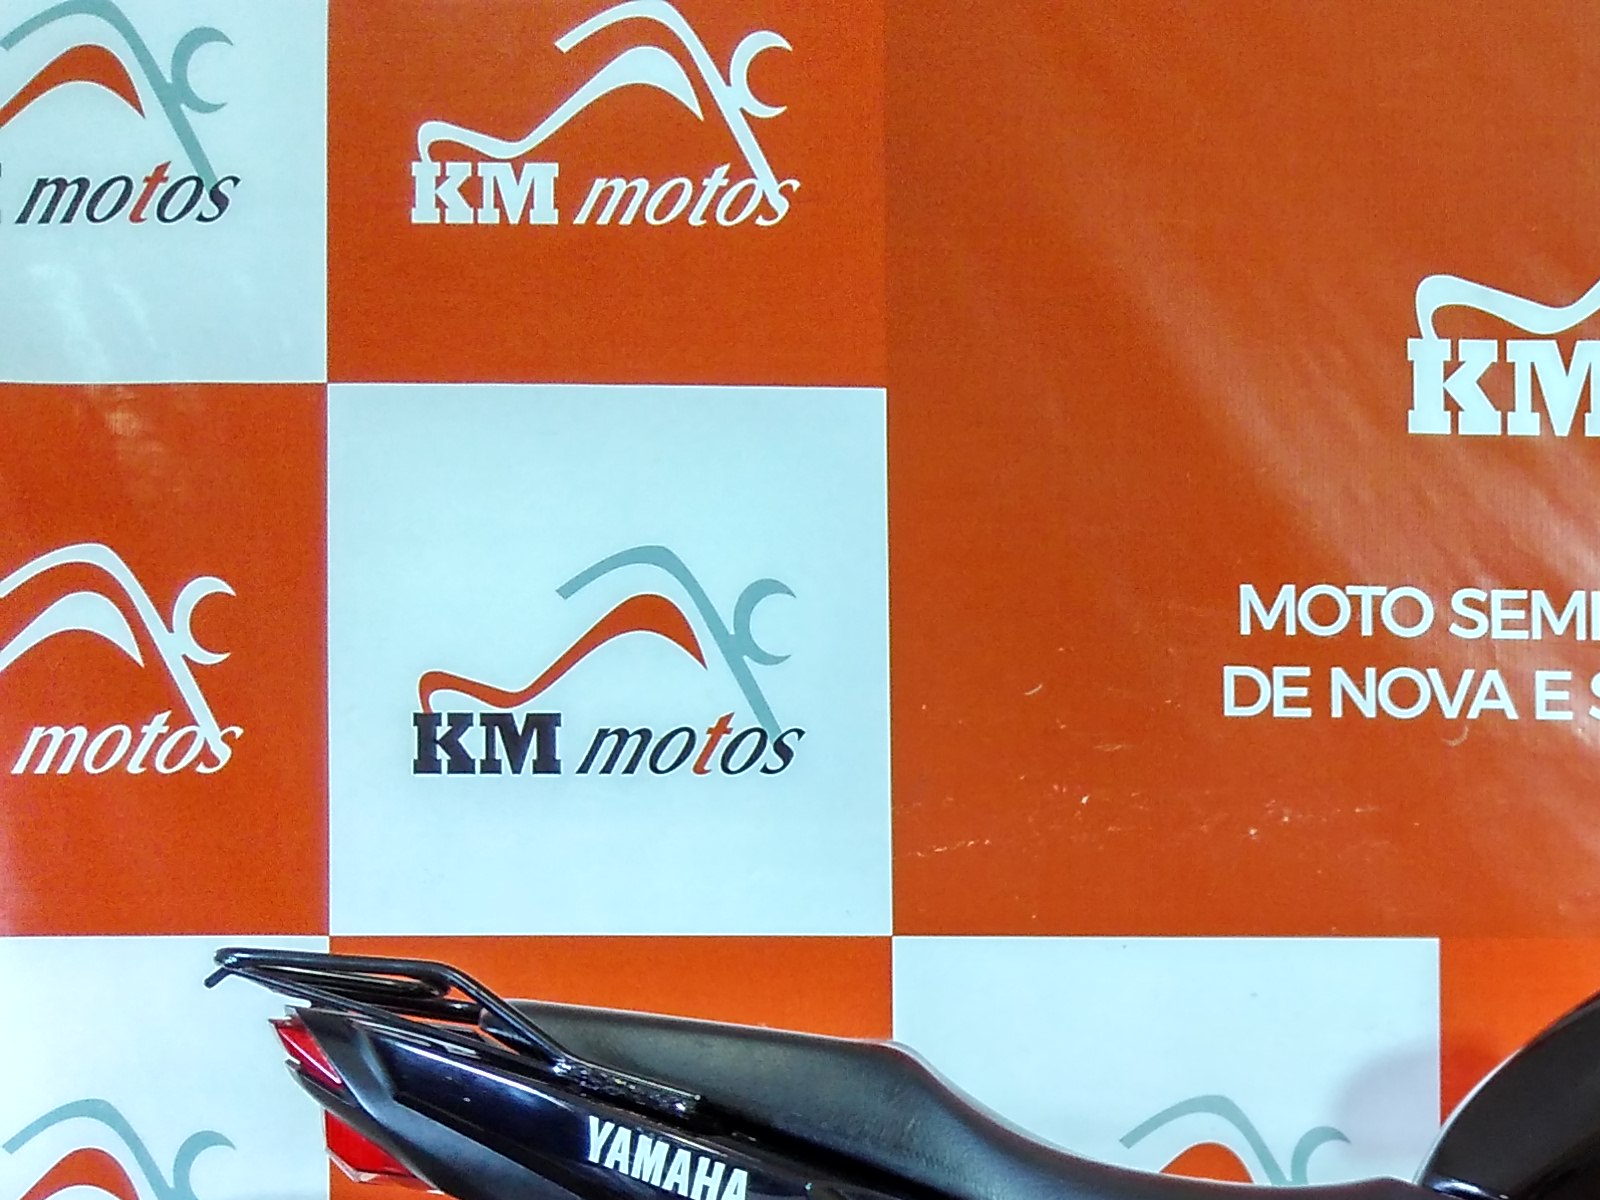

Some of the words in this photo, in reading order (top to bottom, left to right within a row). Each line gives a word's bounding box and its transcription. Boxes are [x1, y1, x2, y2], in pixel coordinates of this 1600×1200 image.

[15, 160, 241, 226] motos
[411, 162, 559, 226] KM
[572, 163, 801, 227] motos
[1239, 584, 1434, 637] MOTO
[1223, 665, 1311, 718] DE
[1331, 667, 1516, 721] NOVA
[1534, 670, 1573, 721] E
[12, 711, 243, 776] motos
[413, 712, 562, 776] KM
[575, 711, 805, 777] motos
